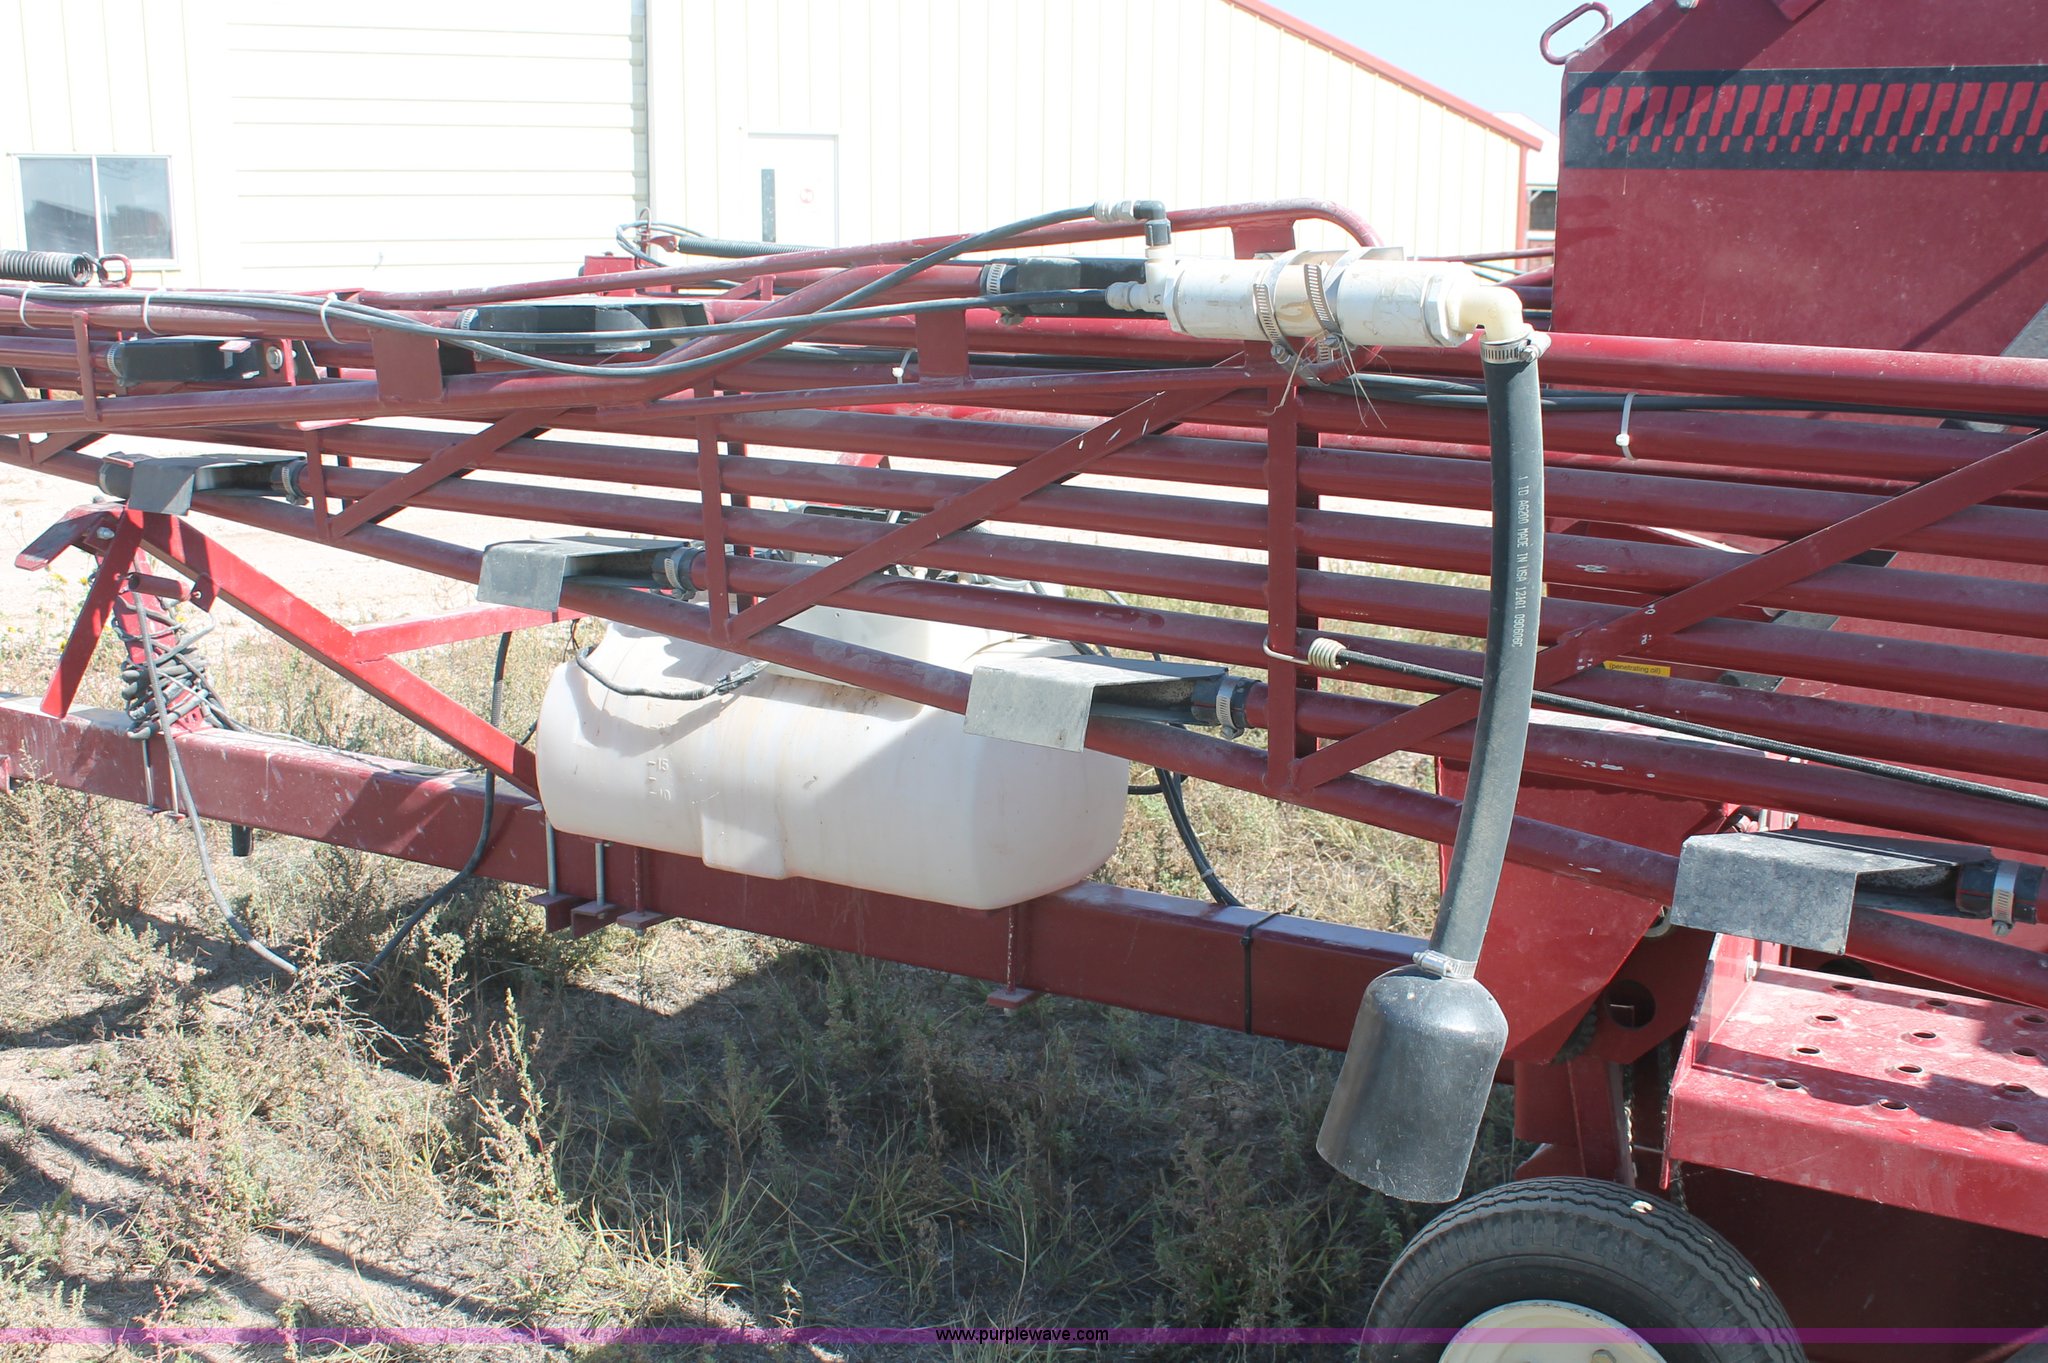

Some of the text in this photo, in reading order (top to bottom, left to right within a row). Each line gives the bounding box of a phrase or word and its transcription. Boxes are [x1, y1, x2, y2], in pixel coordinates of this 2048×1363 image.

[1518, 486, 1529, 496] ID
[1517, 528, 1529, 548] MADE
[1516, 553, 1528, 563] IN
[1516, 566, 1528, 582] USA
